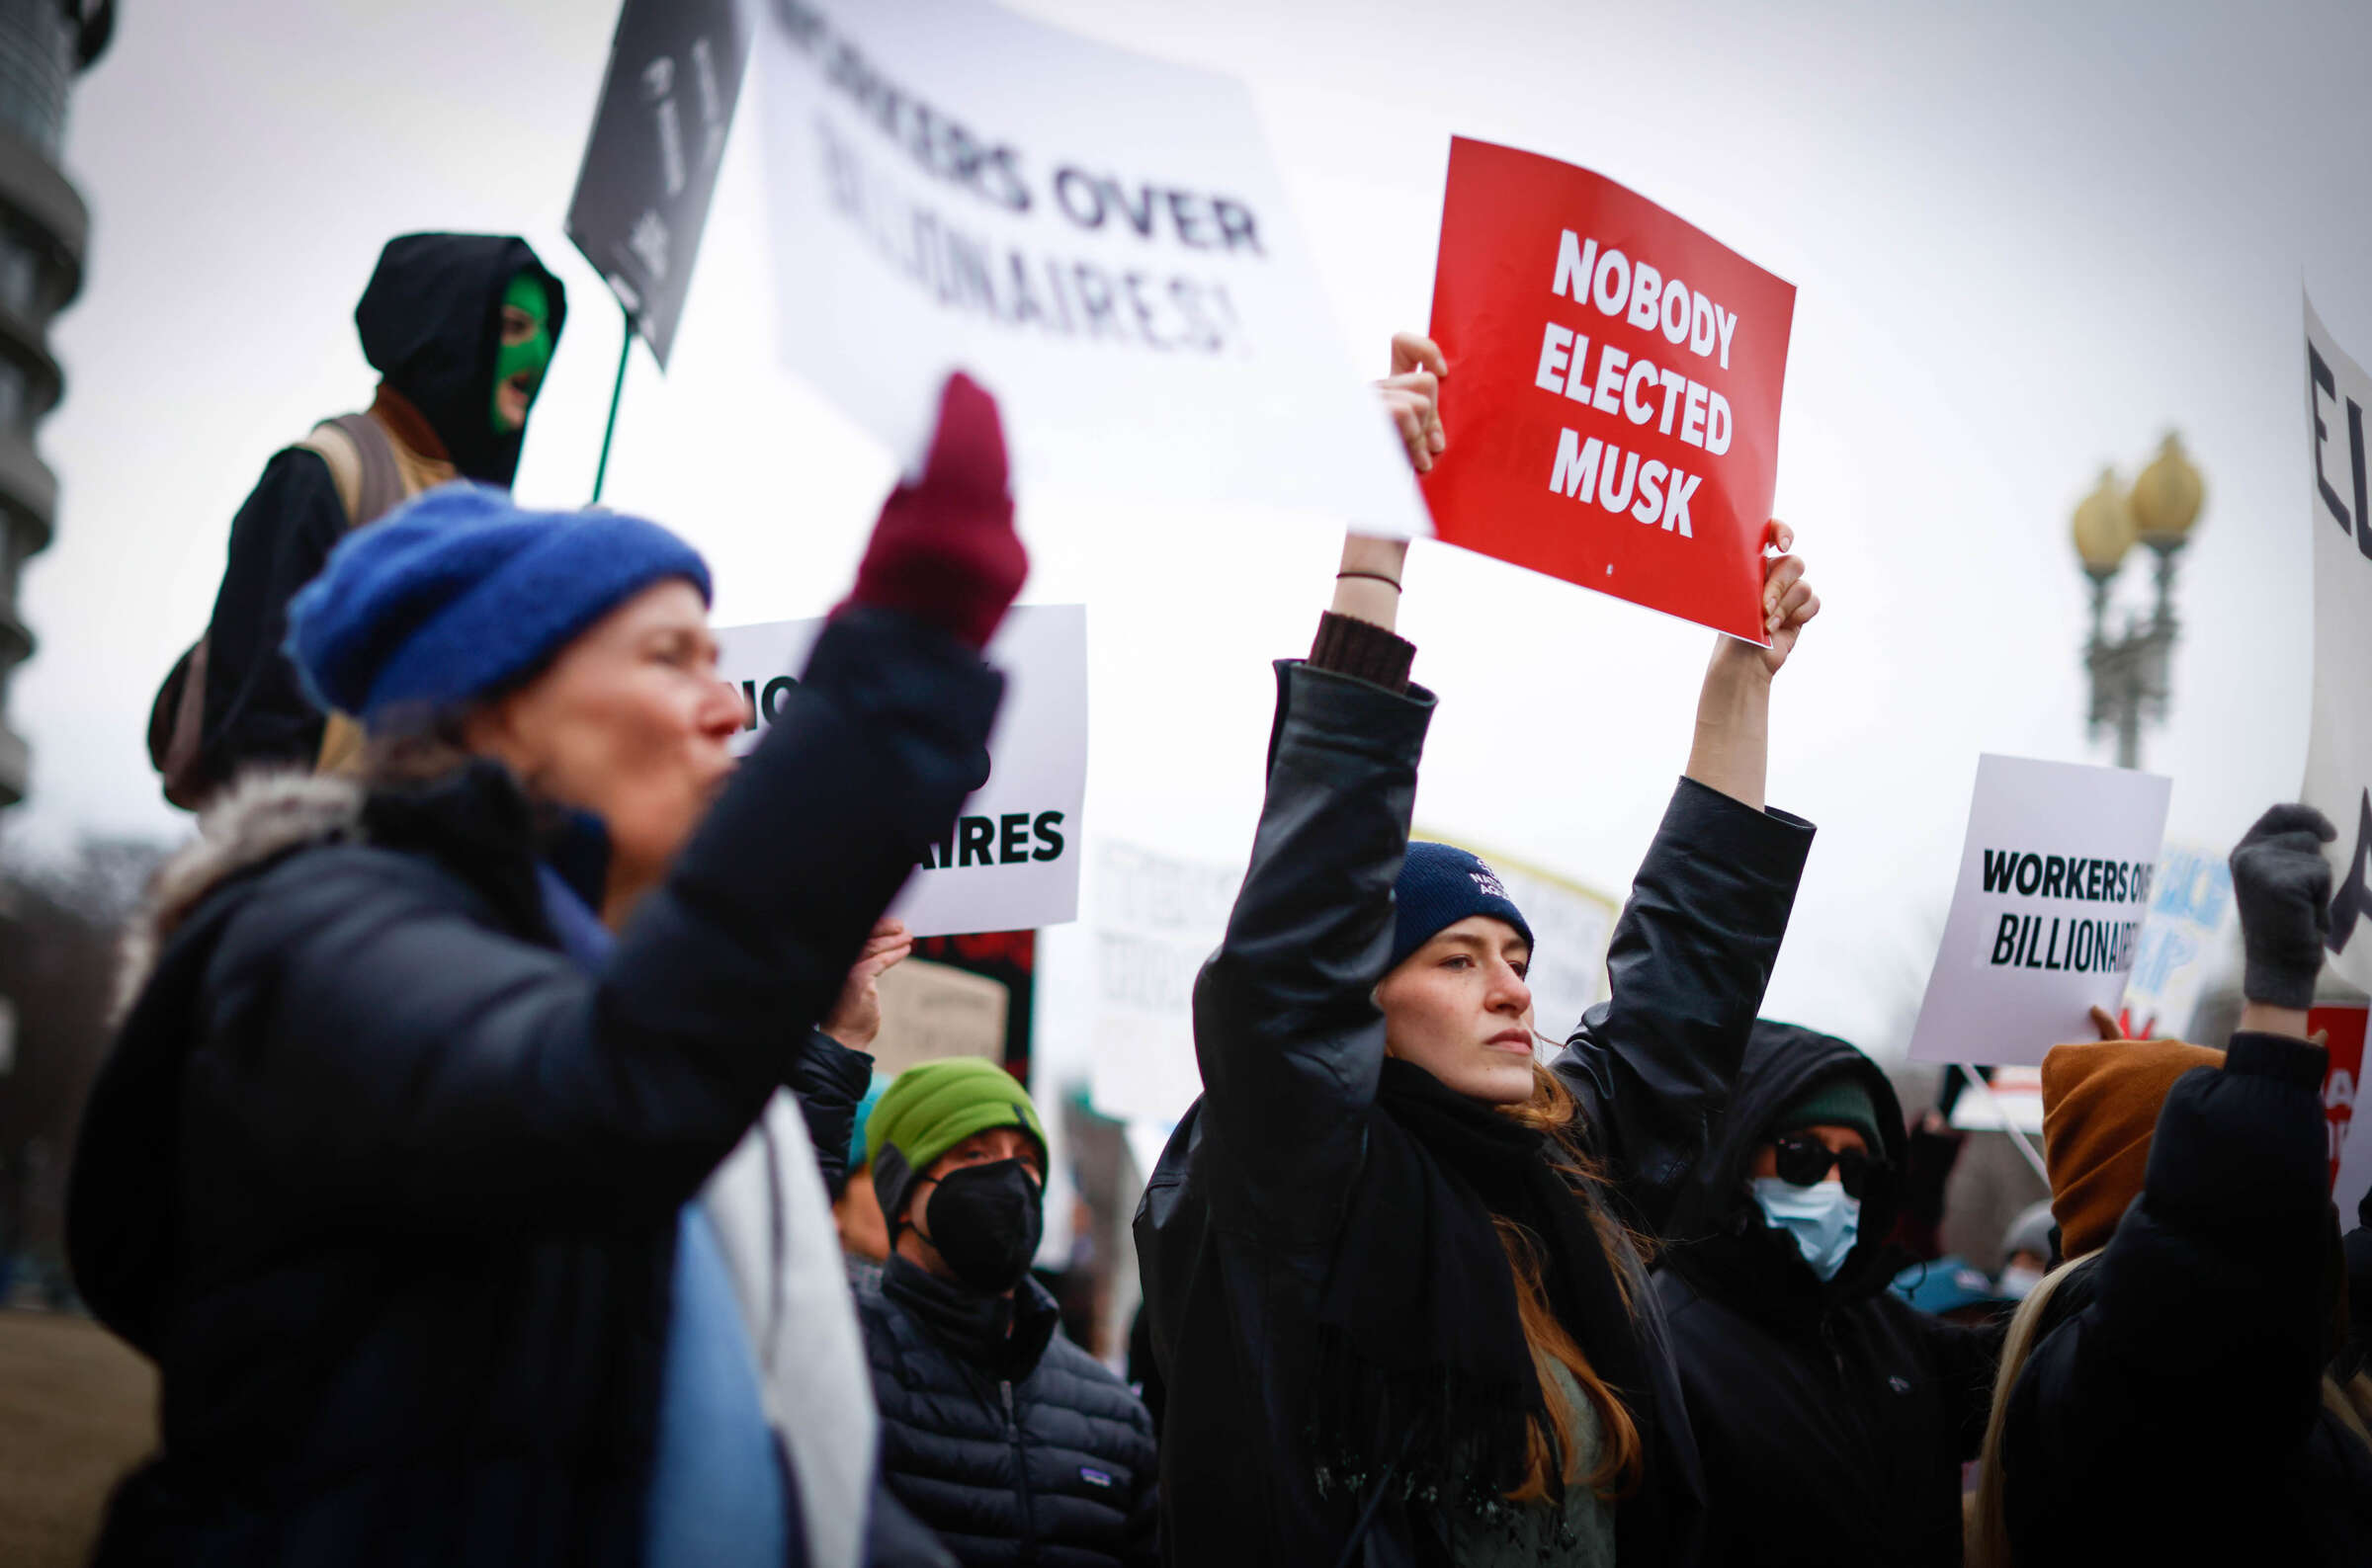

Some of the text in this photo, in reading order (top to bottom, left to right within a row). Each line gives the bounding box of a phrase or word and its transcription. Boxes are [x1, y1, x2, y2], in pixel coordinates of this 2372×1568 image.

[1052, 164, 1268, 260] OVER
[1552, 227, 1738, 371] NOBODY
[1535, 321, 1733, 455] ELECTED
[1549, 426, 1703, 538] MUSK
[1983, 849, 2130, 903] WORKERS
